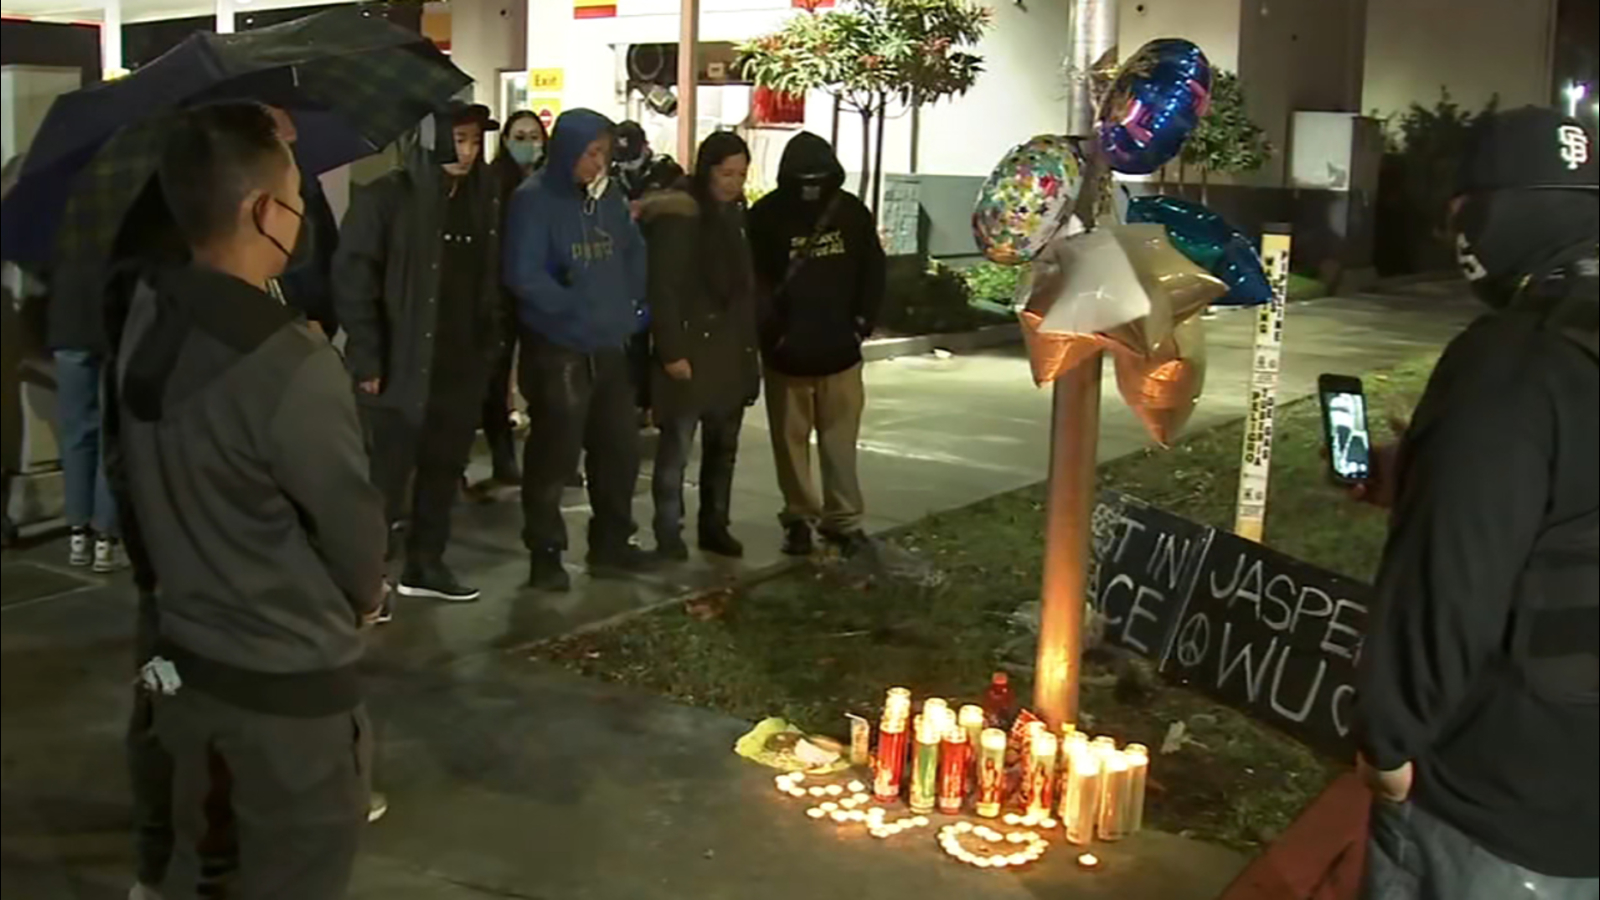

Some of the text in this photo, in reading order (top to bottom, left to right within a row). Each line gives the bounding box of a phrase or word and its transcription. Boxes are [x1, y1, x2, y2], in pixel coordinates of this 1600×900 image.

[534, 73, 557, 88] Exit
[1245, 391, 1261, 463] PELIGRO
[1147, 532, 1190, 589] IN
[1216, 621, 1328, 722] WU
